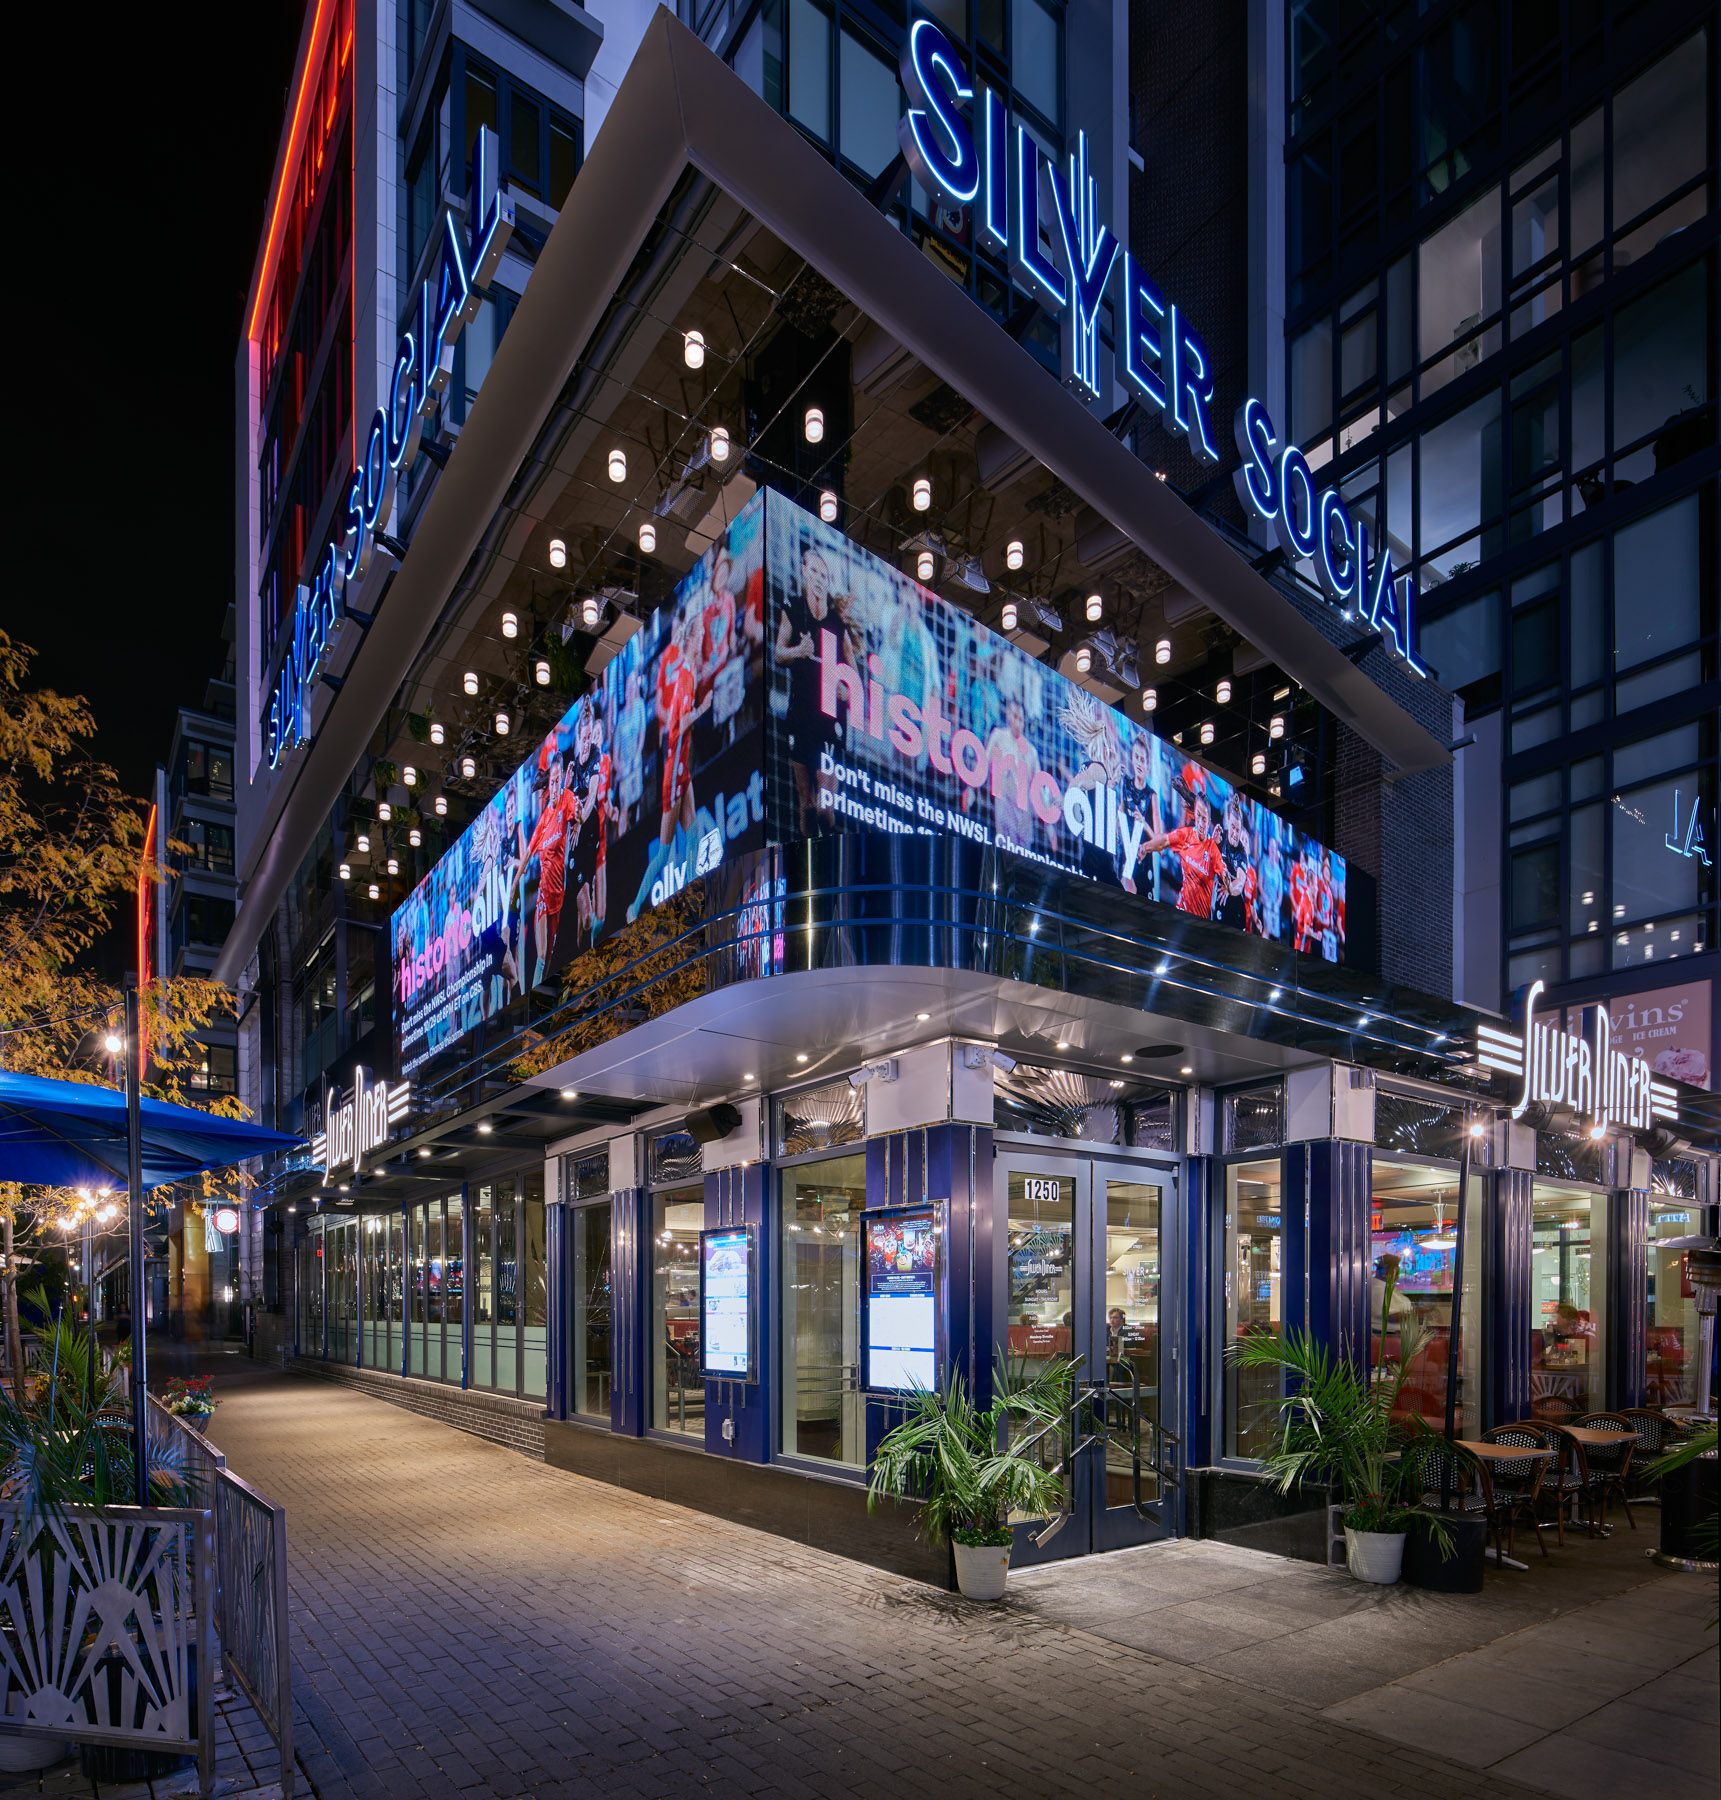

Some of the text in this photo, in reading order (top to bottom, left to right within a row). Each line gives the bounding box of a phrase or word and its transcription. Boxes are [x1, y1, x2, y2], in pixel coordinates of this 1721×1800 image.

[903, 19, 1427, 679] SILVER SOCIAL
[268, 123, 500, 770] SILVER SOCIAL
[820, 751, 871, 794] Don't
[874, 781, 914, 812] miss
[917, 797, 945, 826] the
[947, 810, 992, 846] NWSL
[651, 861, 687, 906] ally
[401, 1027, 423, 1052] primetime
[437, 1009, 443, 1024] at
[454, 994, 461, 1011] ET
[462, 991, 469, 1005] on
[402, 1015, 413, 1034] Don't
[413, 1009, 423, 1026] miss
[432, 989, 446, 1011] NWSL
[447, 958, 485, 998] Championship
[486, 953, 493, 968] in
[1632, 1031, 1646, 1042] ICE
[1648, 1025, 1677, 1039] CREAM
[1511, 979, 1651, 1139] SILVER DINER
[322, 1064, 388, 1188] SILVER DINER
[1026, 1179, 1059, 1201] 1250
[1122, 1266, 1145, 1277] SILVER
